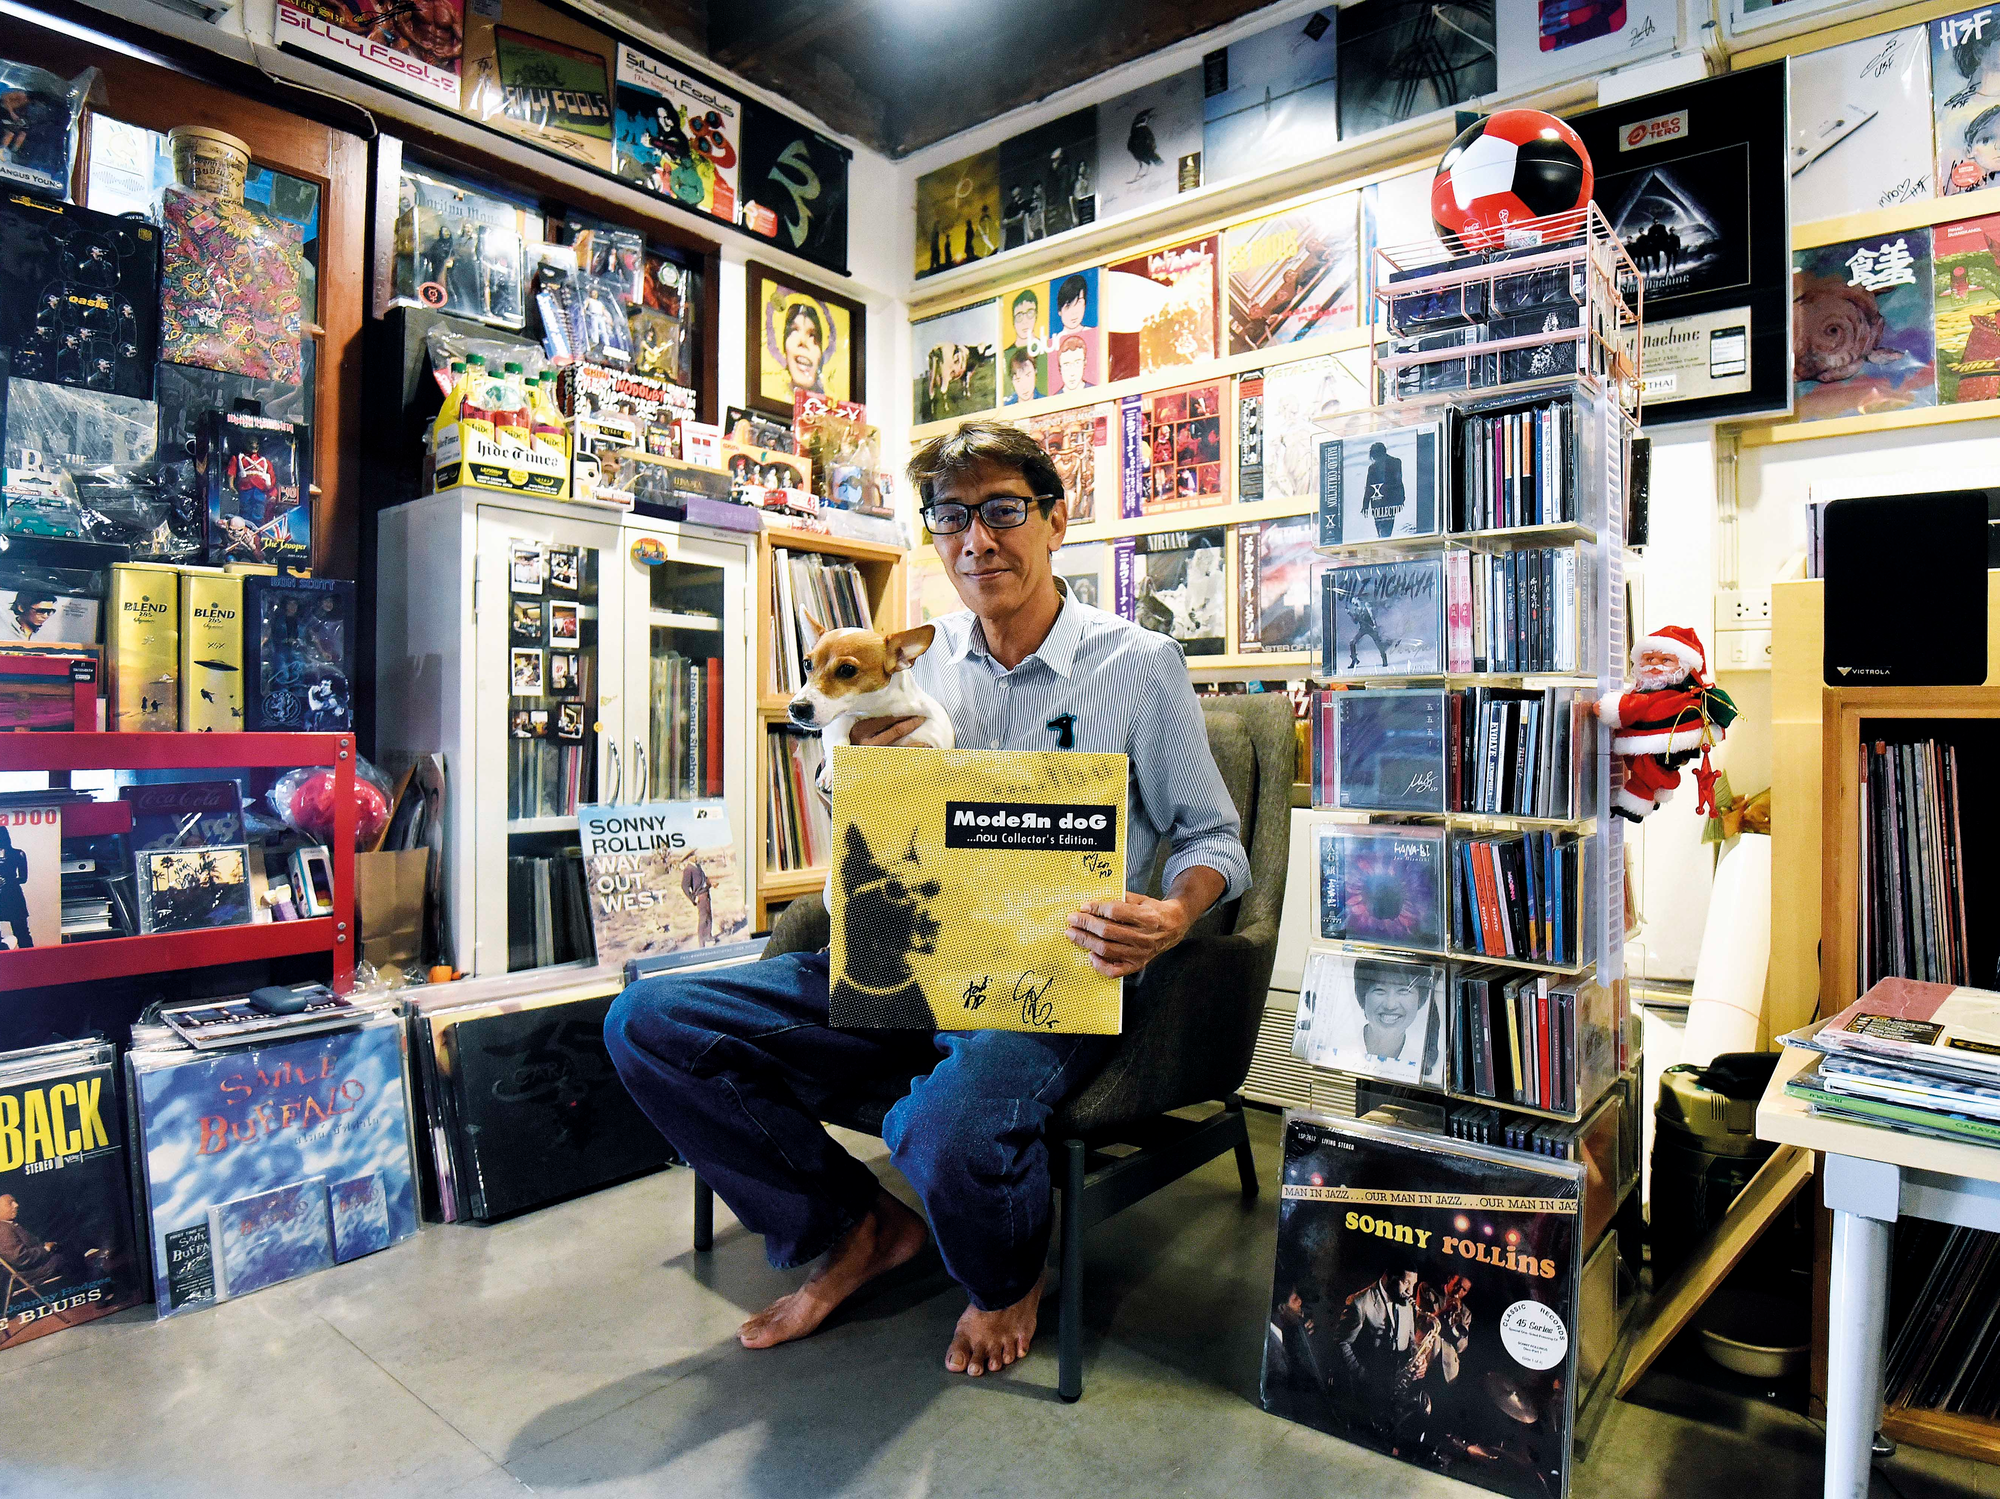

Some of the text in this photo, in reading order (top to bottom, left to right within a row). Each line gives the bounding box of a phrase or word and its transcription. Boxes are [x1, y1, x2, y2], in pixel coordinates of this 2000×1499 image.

[1940, 10, 1992, 50] H3F
[1649, 125, 1681, 138] TERO
[1651, 118, 1680, 130] BEC
[68, 295, 109, 310] oasis
[1027, 326, 1061, 357] blur
[1649, 379, 1674, 389] THAI
[1327, 471, 1338, 507] COLLECTION
[1370, 483, 1384, 498] X
[1325, 514, 1336, 527] X
[1147, 532, 1189, 551] NIRVANA
[271, 577, 335, 590] BON SCOTT
[124, 602, 168, 613] BLEND
[194, 608, 235, 619] BLEND
[1262, 644, 1289, 653] ASTER
[1490, 721, 1498, 757] EVOLVE
[589, 815, 666, 835] SONNY
[1059, 813, 1107, 830] doG
[592, 833, 686, 854] ROLLINS
[1002, 833, 1055, 844] Collector's
[1059, 834, 1098, 846] Edition.
[593, 854, 642, 874] WAY
[597, 872, 646, 894] OUT
[600, 890, 668, 914] WEST
[220, 1056, 337, 1105] SMILE
[0, 1077, 109, 1173] BACK
[1321, 1137, 1355, 1151] LIVING STEREO
[25, 1159, 54, 1175] STEREO
[1284, 1187, 1307, 1197] MAN
[1310, 1189, 1322, 1198] IN
[1390, 1193, 1416, 1203] MAN
[1418, 1194, 1432, 1204] IN
[1508, 1199, 1536, 1210] MAN
[1539, 1200, 1554, 1210] IN
[178, 1234, 207, 1248] SMIL
[172, 1243, 210, 1262] BUFFA
[7, 1277, 112, 1313] Johnny Hodges
[18, 1288, 102, 1324] BLUES
[1502, 1304, 1565, 1341] CLASSIC RECORDS
[1515, 1318, 1527, 1327] 45
